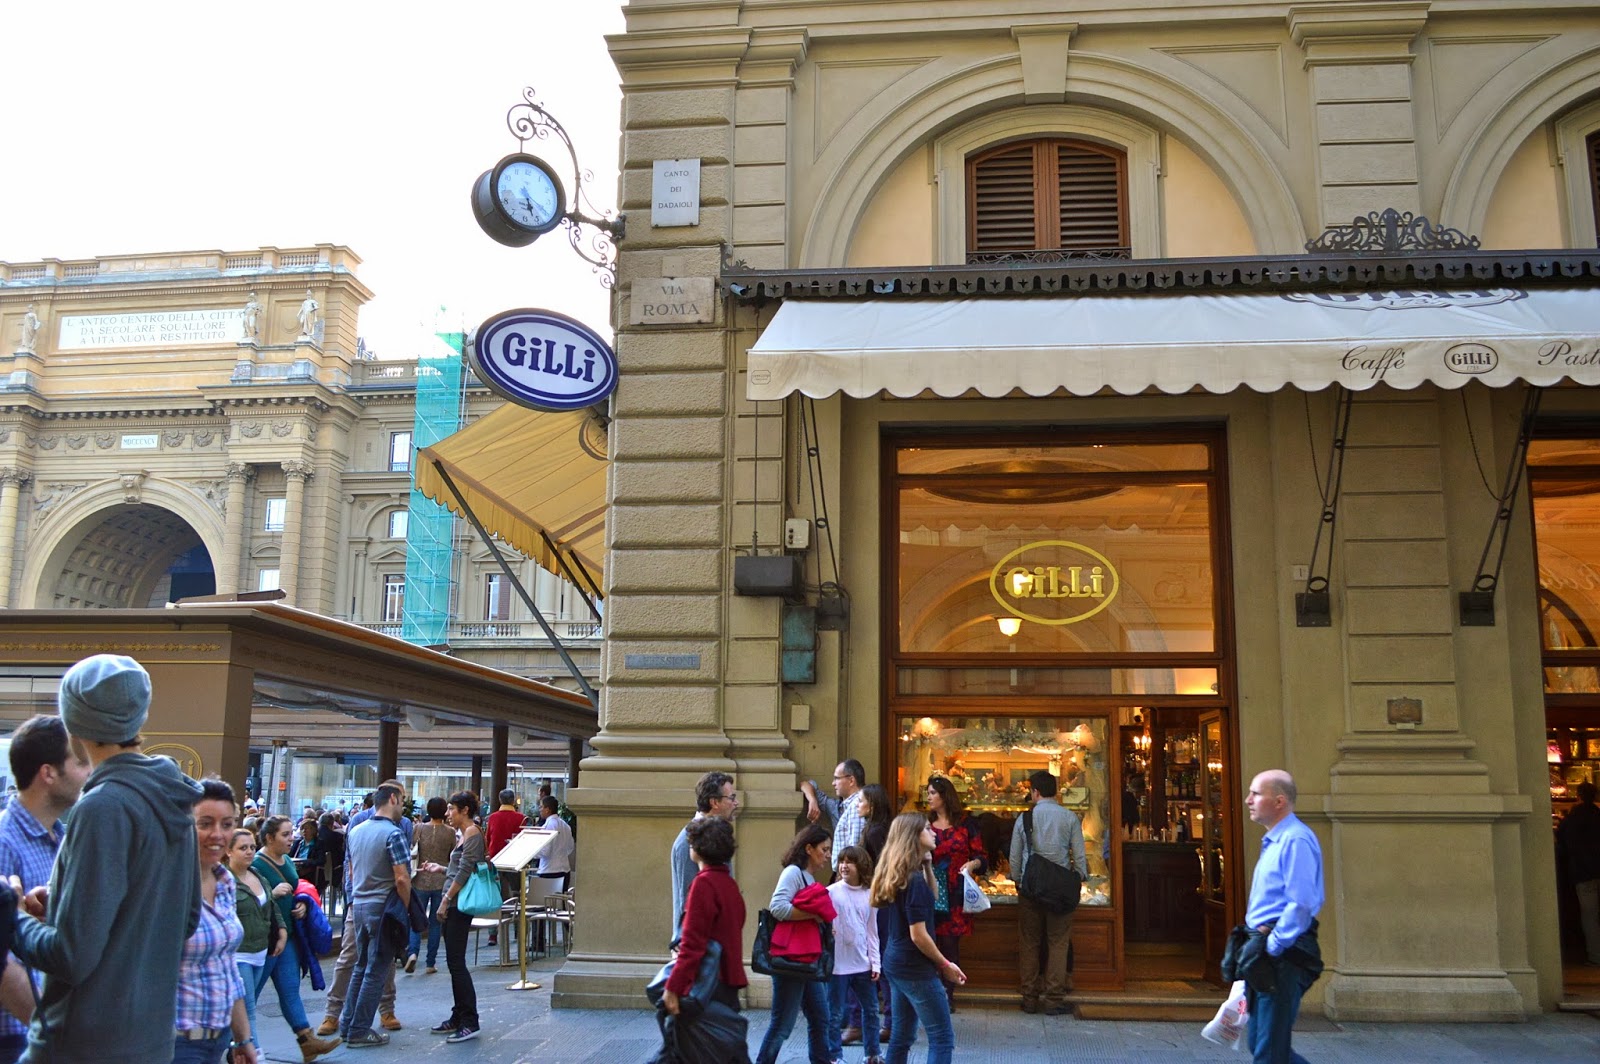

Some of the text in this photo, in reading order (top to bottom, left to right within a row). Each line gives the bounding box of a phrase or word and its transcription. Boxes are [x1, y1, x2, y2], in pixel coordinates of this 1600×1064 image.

[663, 170, 690, 178] CANTO
[658, 201, 693, 209] DADAIOLI
[661, 285, 684, 296] VIA
[643, 303, 700, 316] ROMA
[120, 314, 165, 325] CENTRO
[168, 312, 206, 323] DELLA
[99, 324, 156, 335] SECOLARE
[160, 321, 226, 333] SQUALLORE
[120, 333, 156, 344] NUOVA
[160, 330, 226, 342] RESTITUITO
[1538, 341, 1600, 366] Past
